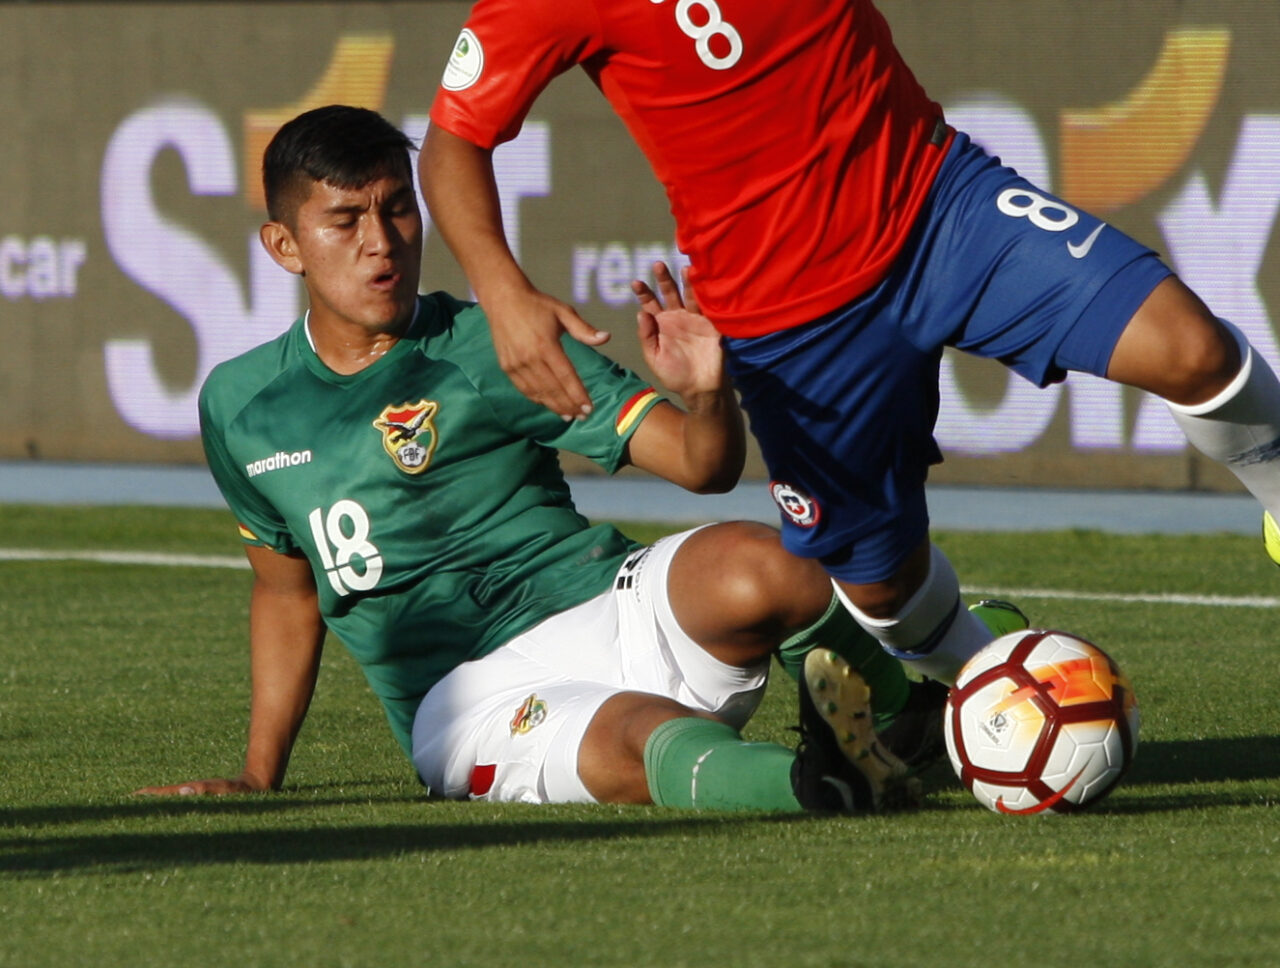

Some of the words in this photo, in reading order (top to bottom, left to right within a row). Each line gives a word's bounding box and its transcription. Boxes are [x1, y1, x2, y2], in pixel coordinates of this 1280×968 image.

[996, 188, 1079, 232] 8
[0, 234, 87, 299] car
[246, 449, 312, 477] marathon
[308, 499, 383, 597] 18
